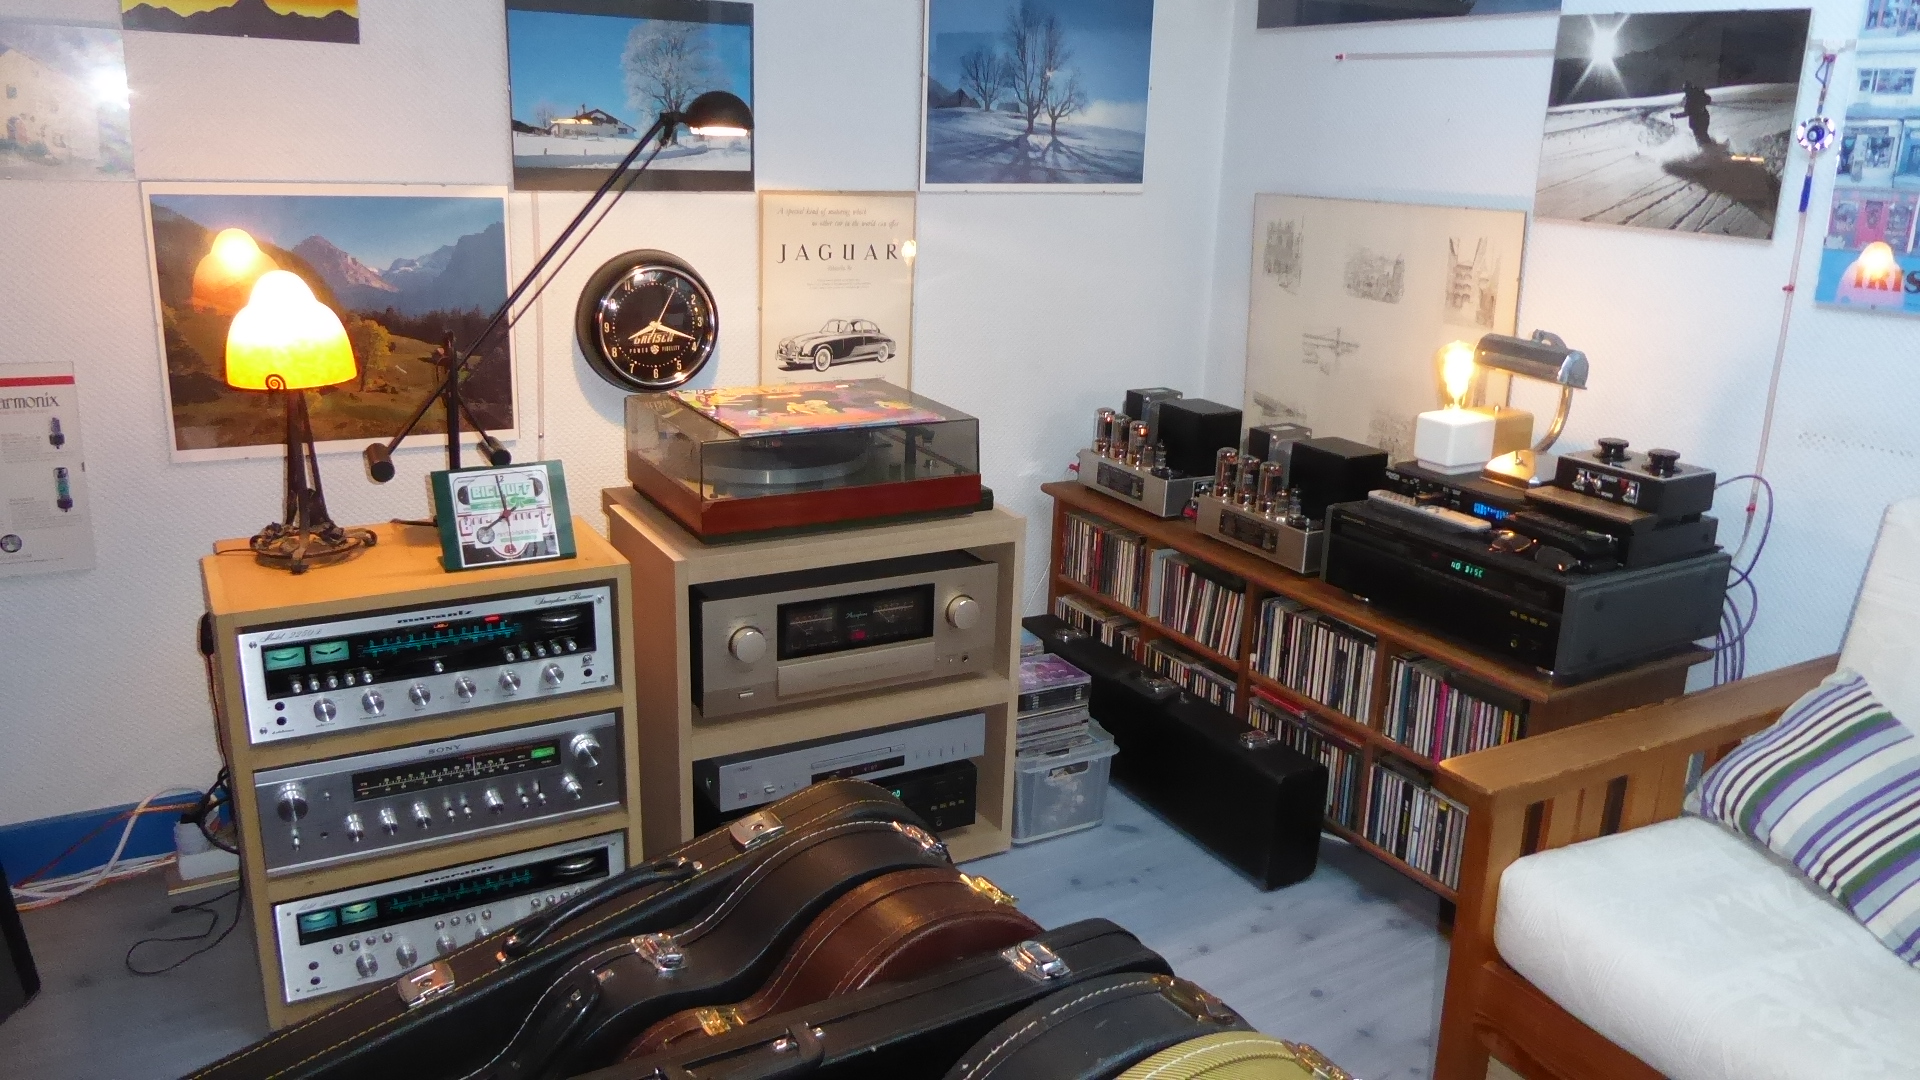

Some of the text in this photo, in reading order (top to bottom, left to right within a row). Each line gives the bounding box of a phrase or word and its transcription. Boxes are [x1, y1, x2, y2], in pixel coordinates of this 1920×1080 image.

[776, 243, 898, 264] JAGUAR
[624, 281, 631, 292] 11
[690, 293, 696, 306] 2
[697, 316, 703, 328] 3
[604, 322, 610, 334] 9
[691, 341, 697, 352] 4
[611, 347, 618, 358] 8
[629, 363, 635, 375] 7
[676, 360, 682, 371] 5
[653, 368, 659, 379] 6
[471, 484, 495, 499] BIG
[428, 744, 461, 755] SONY
